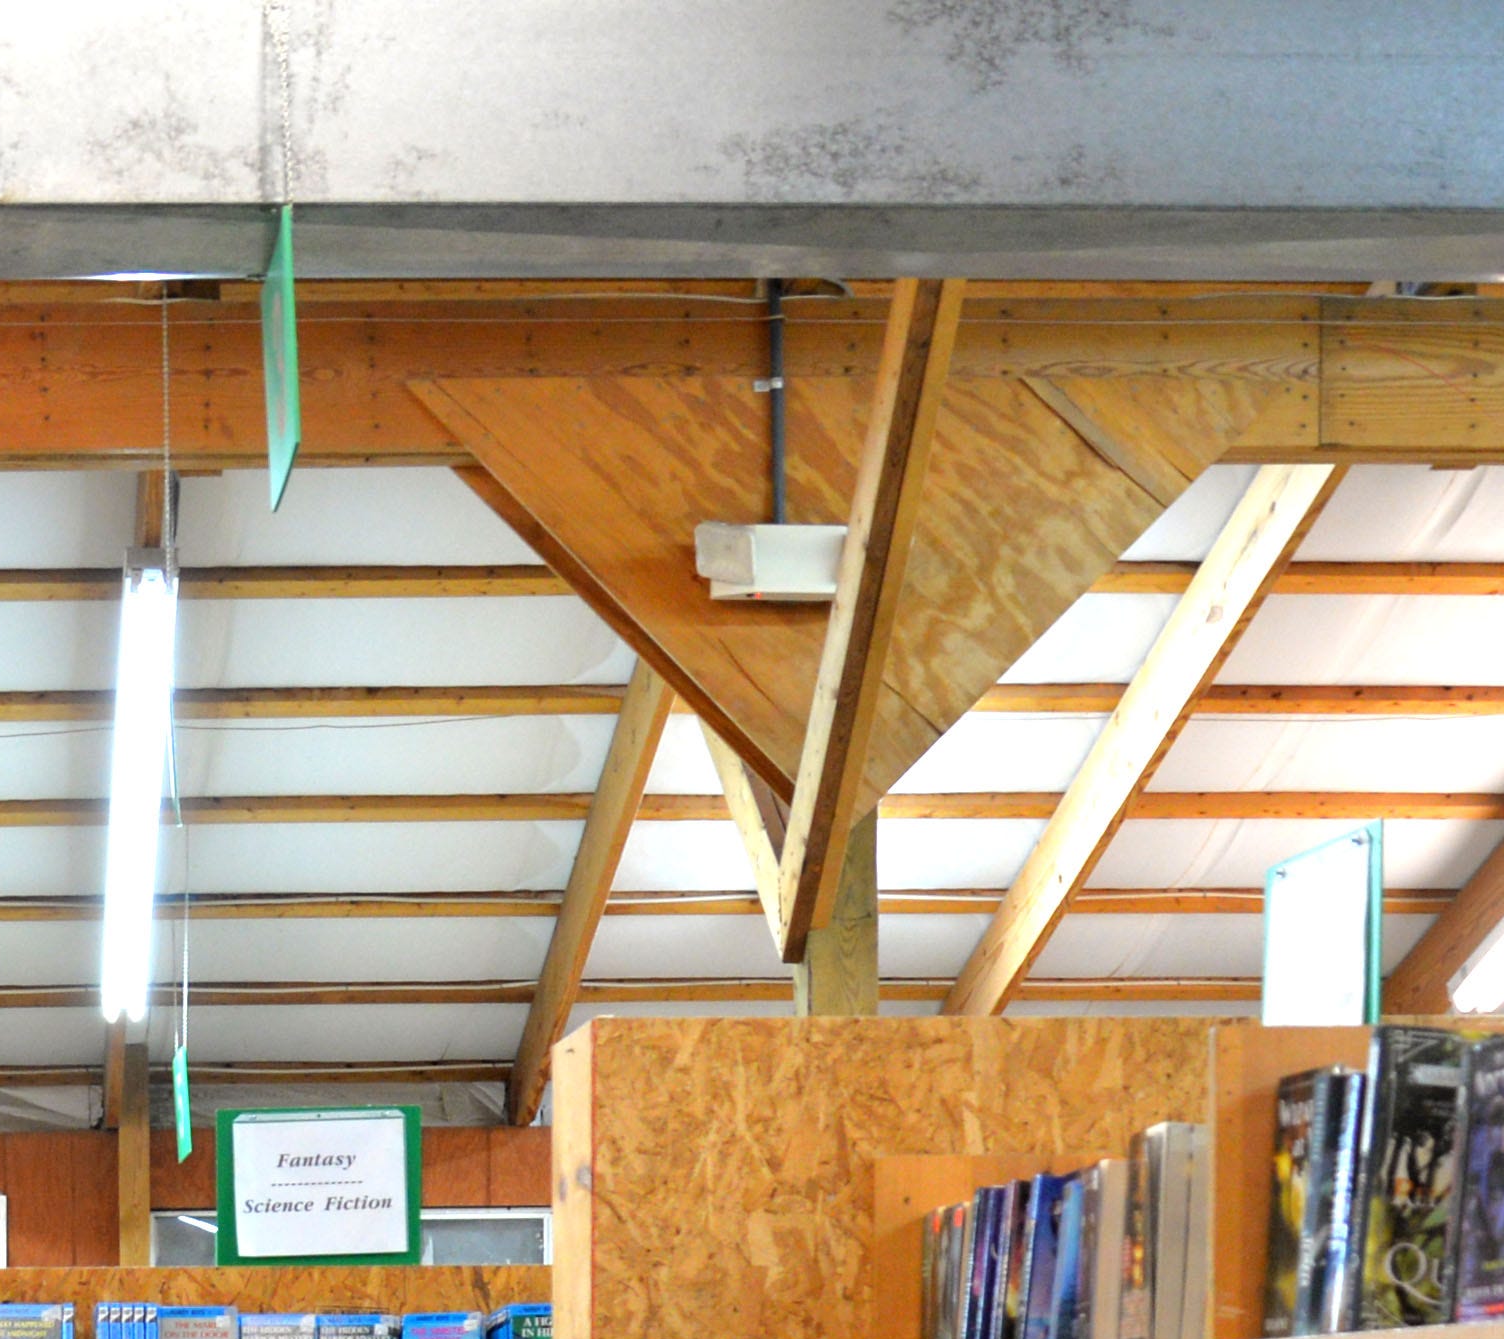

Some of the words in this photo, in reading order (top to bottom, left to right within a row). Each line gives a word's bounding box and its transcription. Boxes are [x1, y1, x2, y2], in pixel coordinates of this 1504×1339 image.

[276, 1151, 358, 1171] Fantasy
[243, 1197, 314, 1215] Science
[324, 1195, 393, 1212] Fiction
[522, 1328, 534, 1338] IN
